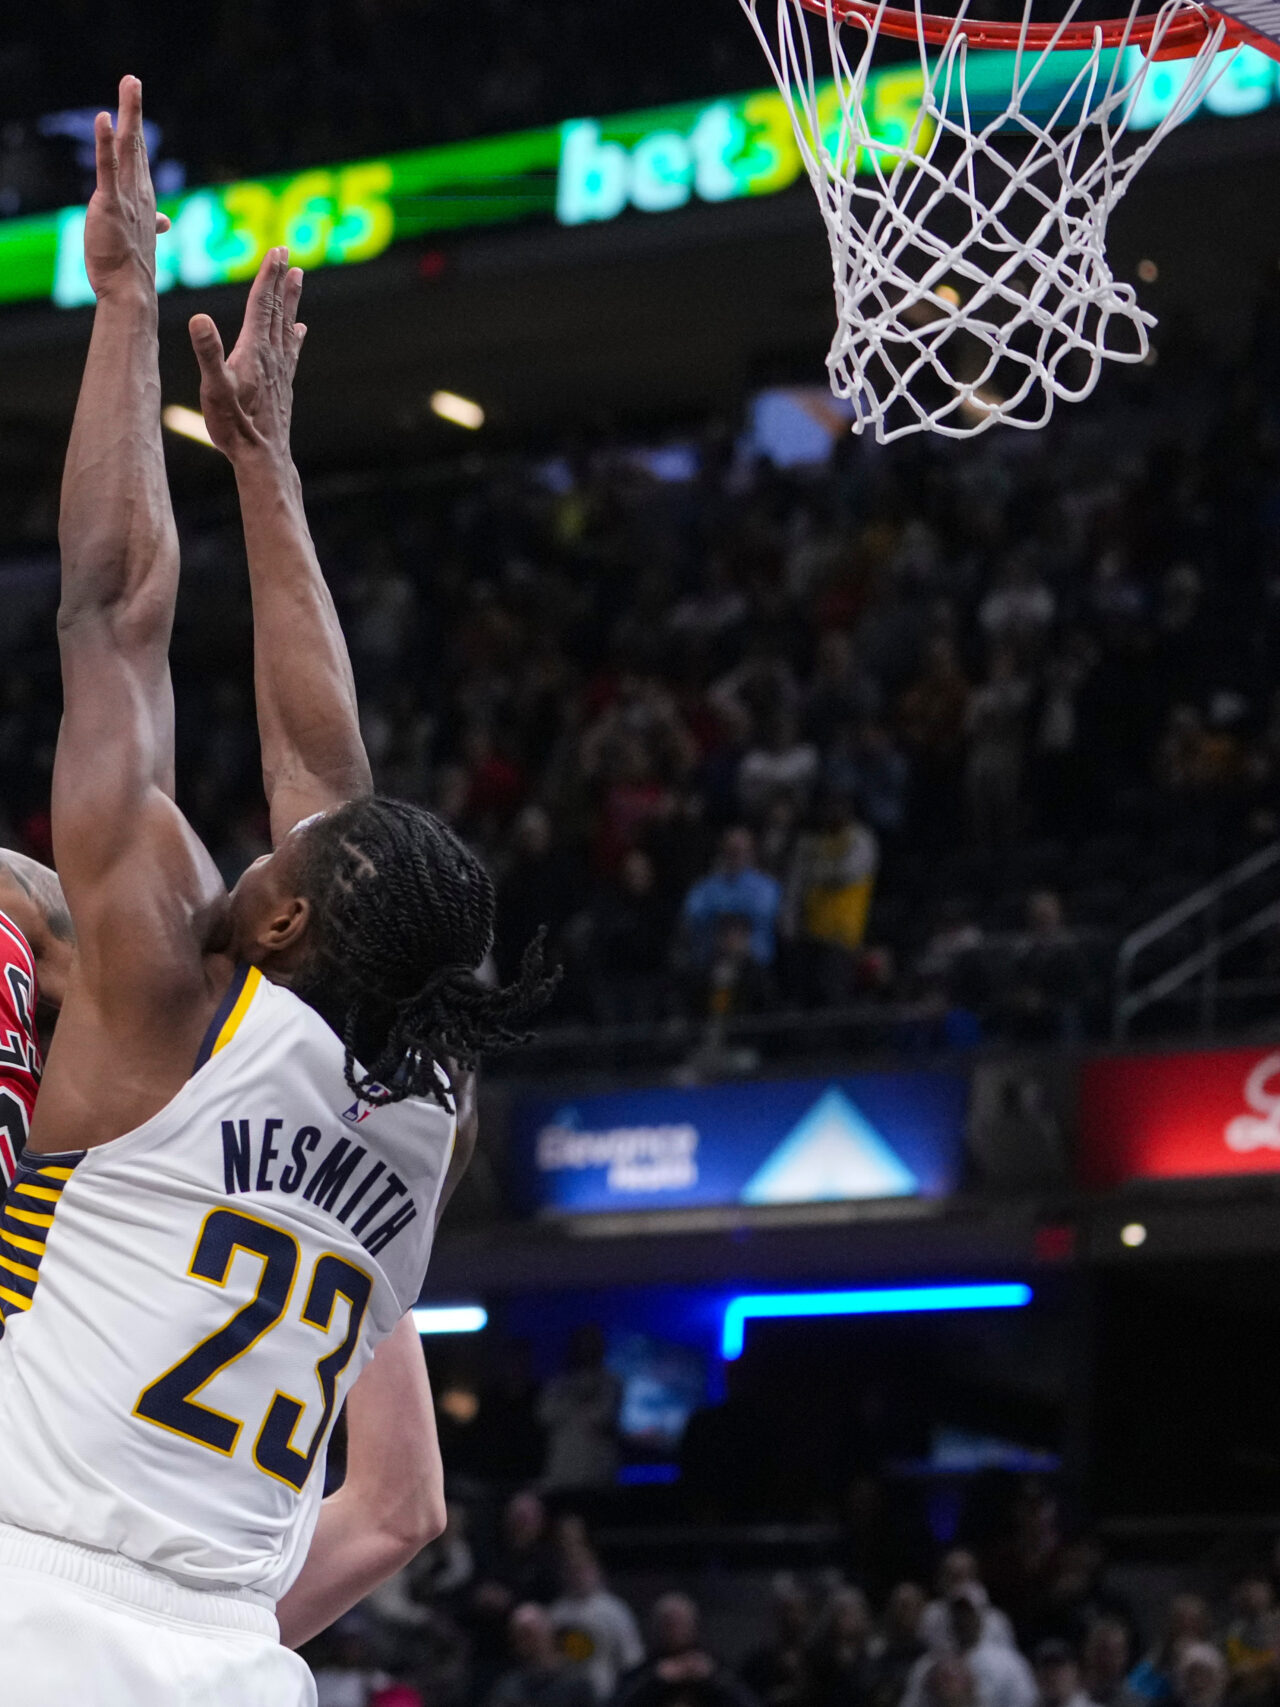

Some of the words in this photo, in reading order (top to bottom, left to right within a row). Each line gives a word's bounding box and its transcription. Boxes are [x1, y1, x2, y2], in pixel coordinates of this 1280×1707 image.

[556, 70, 936, 226] bet365
[1125, 44, 1280, 131] be
[221, 1118, 417, 1257] NESMITH
[131, 1206, 373, 1494] 23
